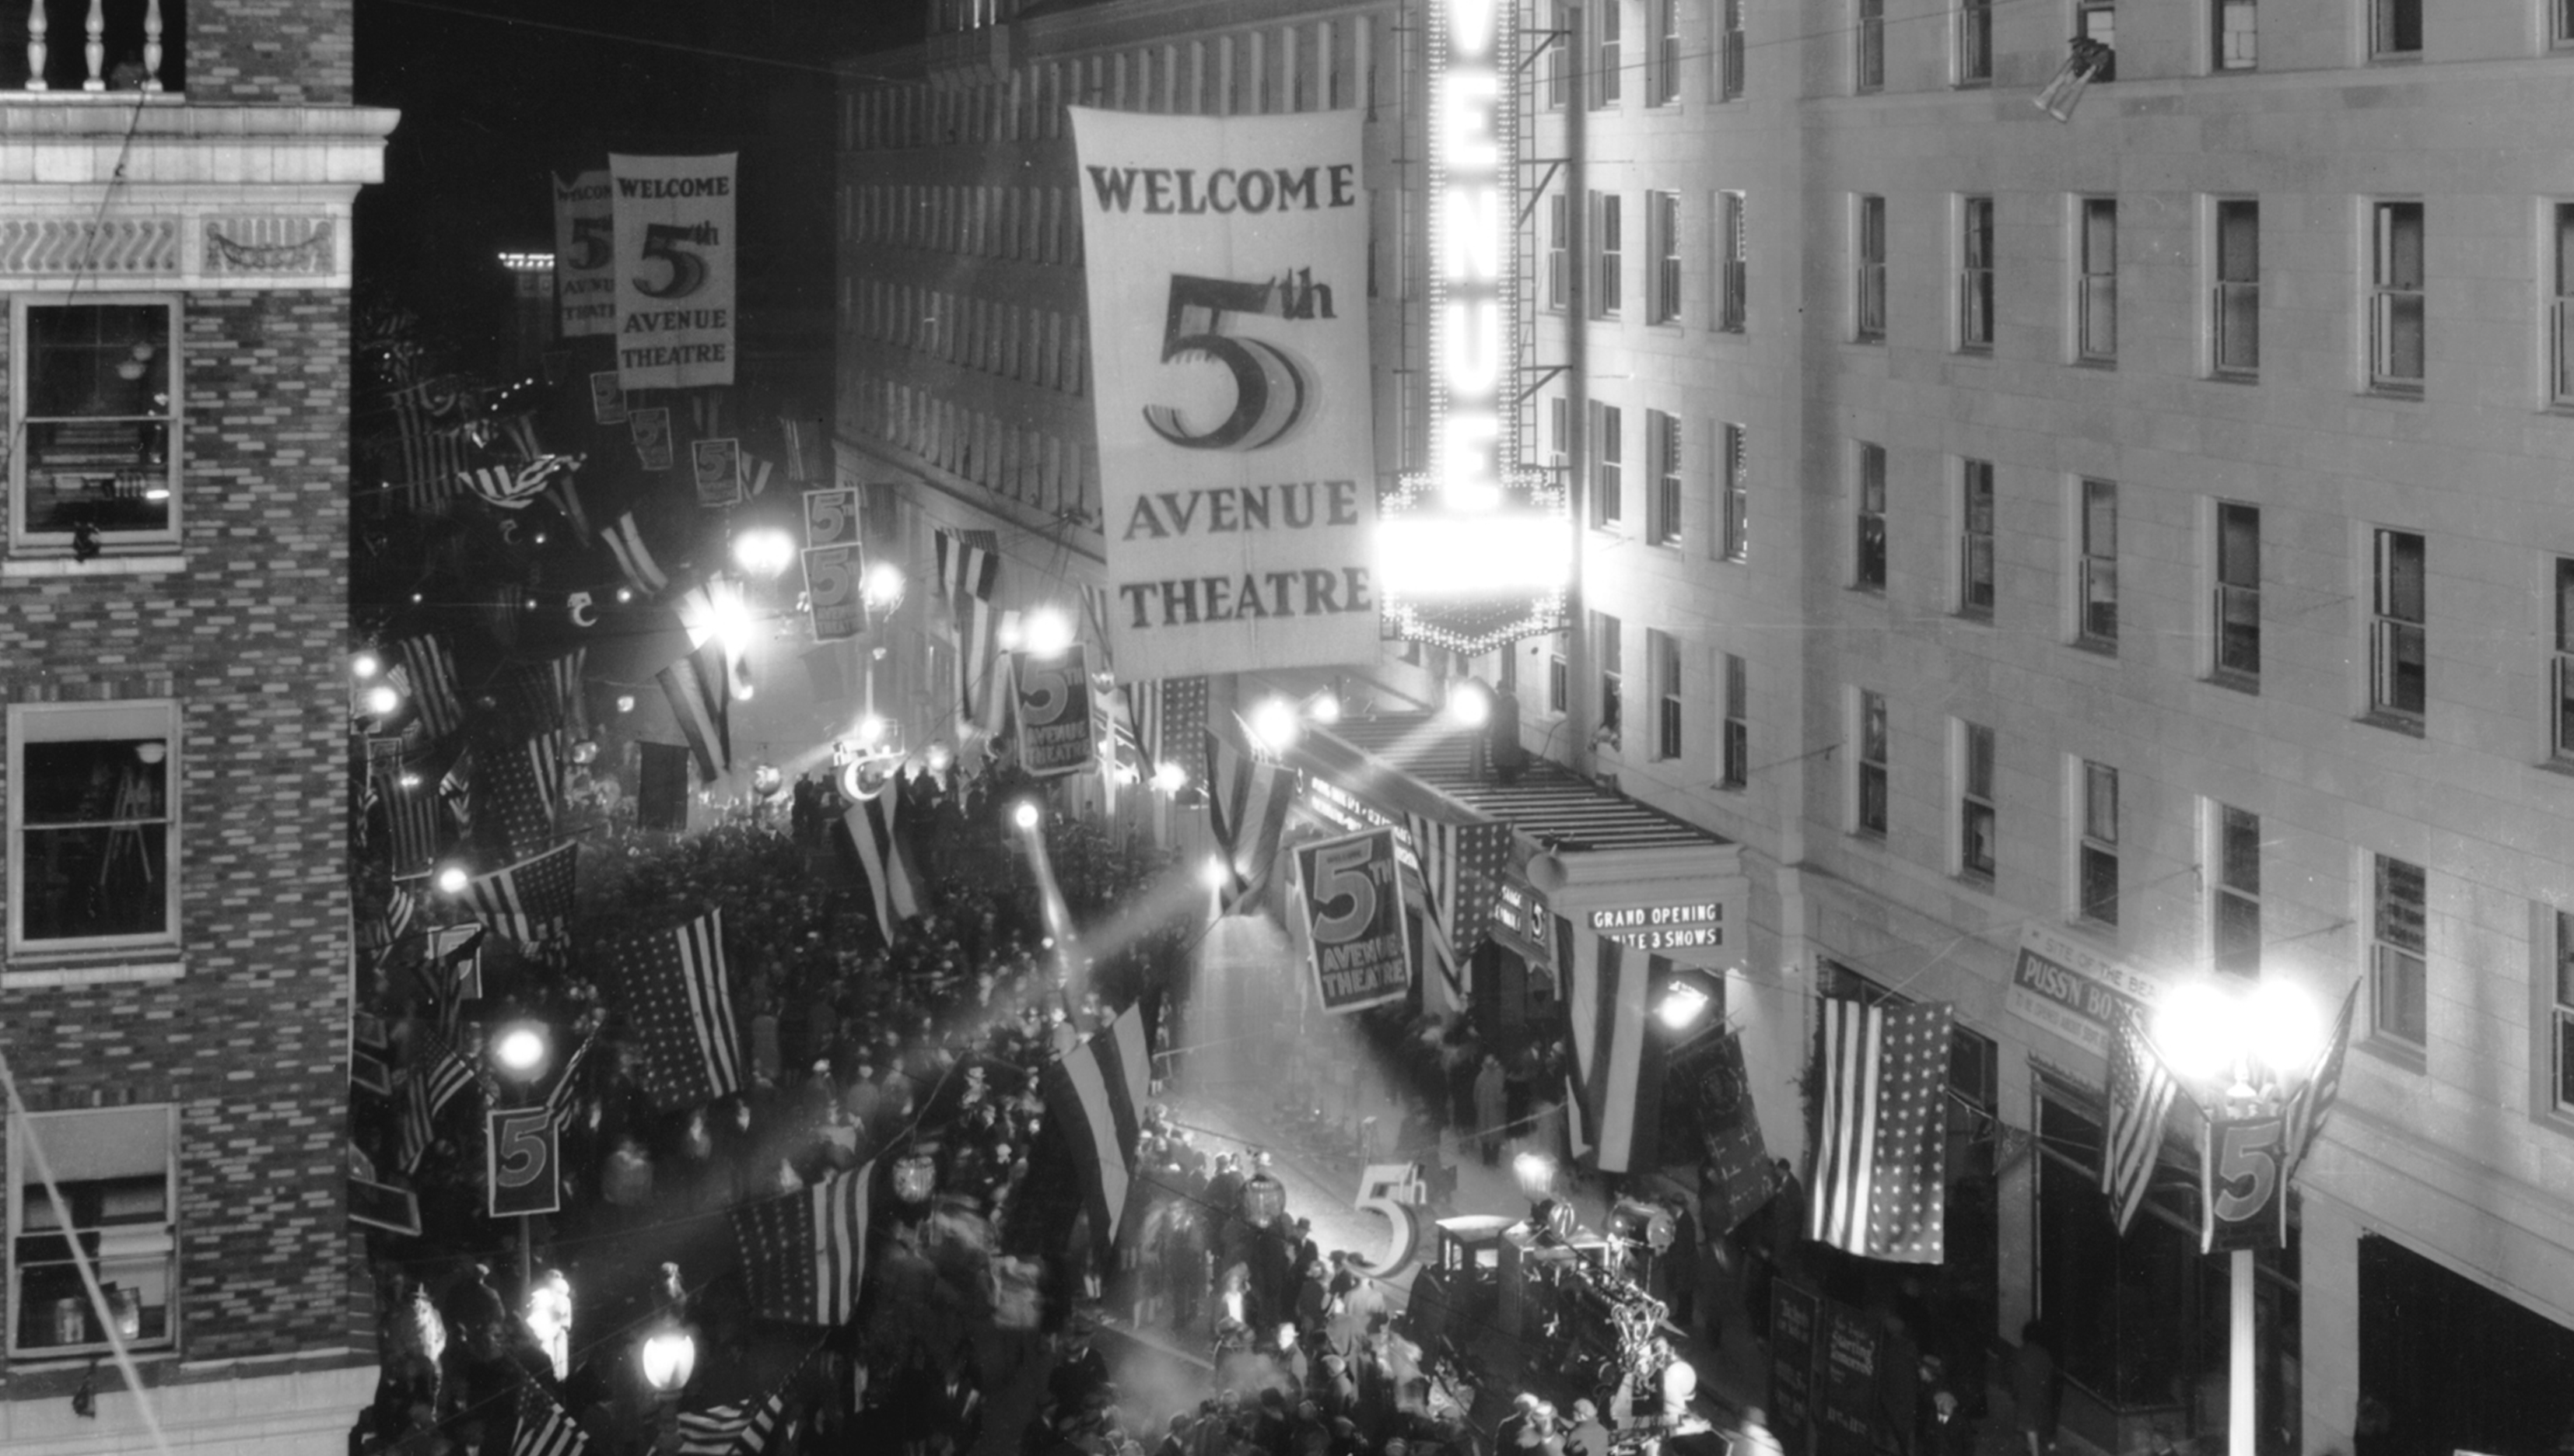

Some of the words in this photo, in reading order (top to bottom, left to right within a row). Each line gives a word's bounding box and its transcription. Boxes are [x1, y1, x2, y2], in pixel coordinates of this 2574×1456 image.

[618, 177, 730, 198] WELCOME
[1087, 164, 1356, 215] WELCOME
[632, 220, 720, 299] 5th
[625, 310, 727, 333] AVENUE
[622, 344, 727, 369] THEATRE
[1143, 266, 1337, 451] 5th
[1122, 480, 1358, 541] AVENUE
[1120, 566, 1372, 629] THEATRE
[1594, 911, 1645, 928] GRAND
[1651, 904, 1715, 925] OPENING
[1322, 933, 1398, 973] AVENUE
[1651, 931, 1661, 948] 3
[1665, 928, 1716, 947] SHOWS
[1322, 957, 1406, 997] THEATRE
[2045, 937, 2074, 964] SITE
[2077, 953, 2095, 969] OF
[2097, 961, 2124, 988] THE
[2086, 985, 2144, 1028] BOTS
[1342, 1162, 1427, 1279] 5th
